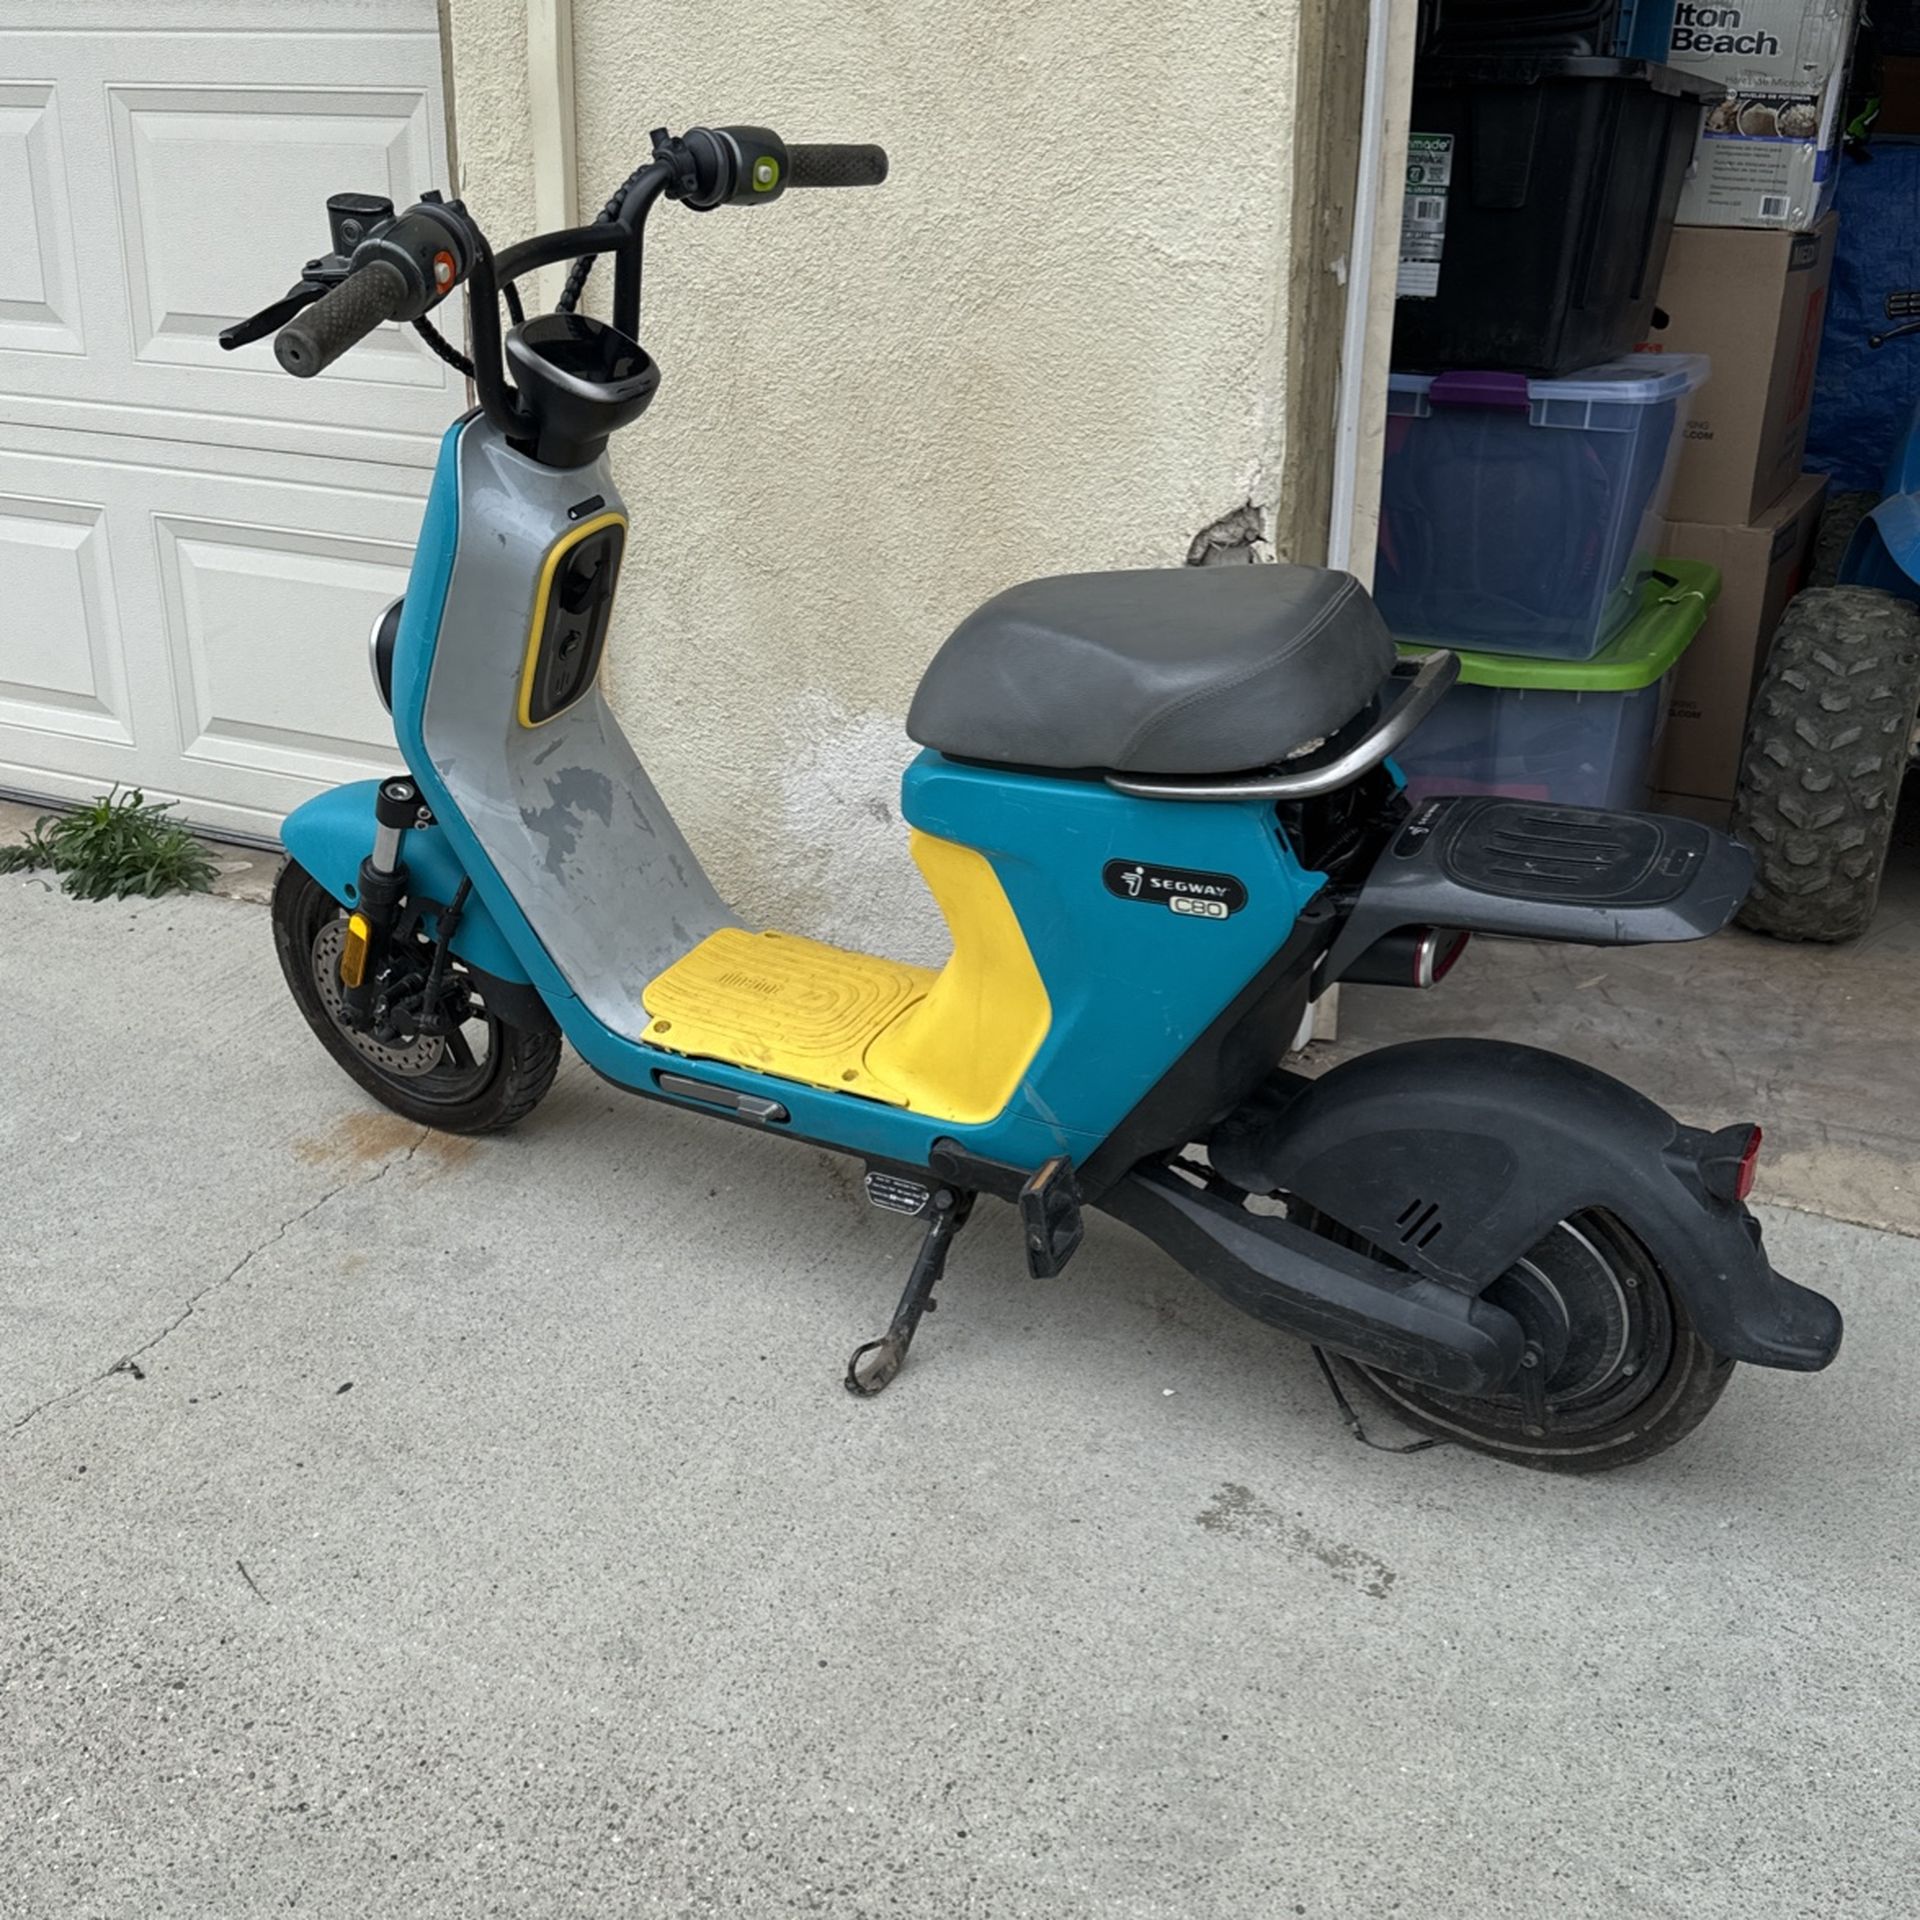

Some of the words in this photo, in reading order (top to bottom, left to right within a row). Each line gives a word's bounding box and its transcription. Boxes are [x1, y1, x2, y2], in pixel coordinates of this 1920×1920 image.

[1670, 28, 1779, 56] Beach
[1150, 878, 1227, 896] SEGWAY
[1175, 899, 1222, 916] C80
